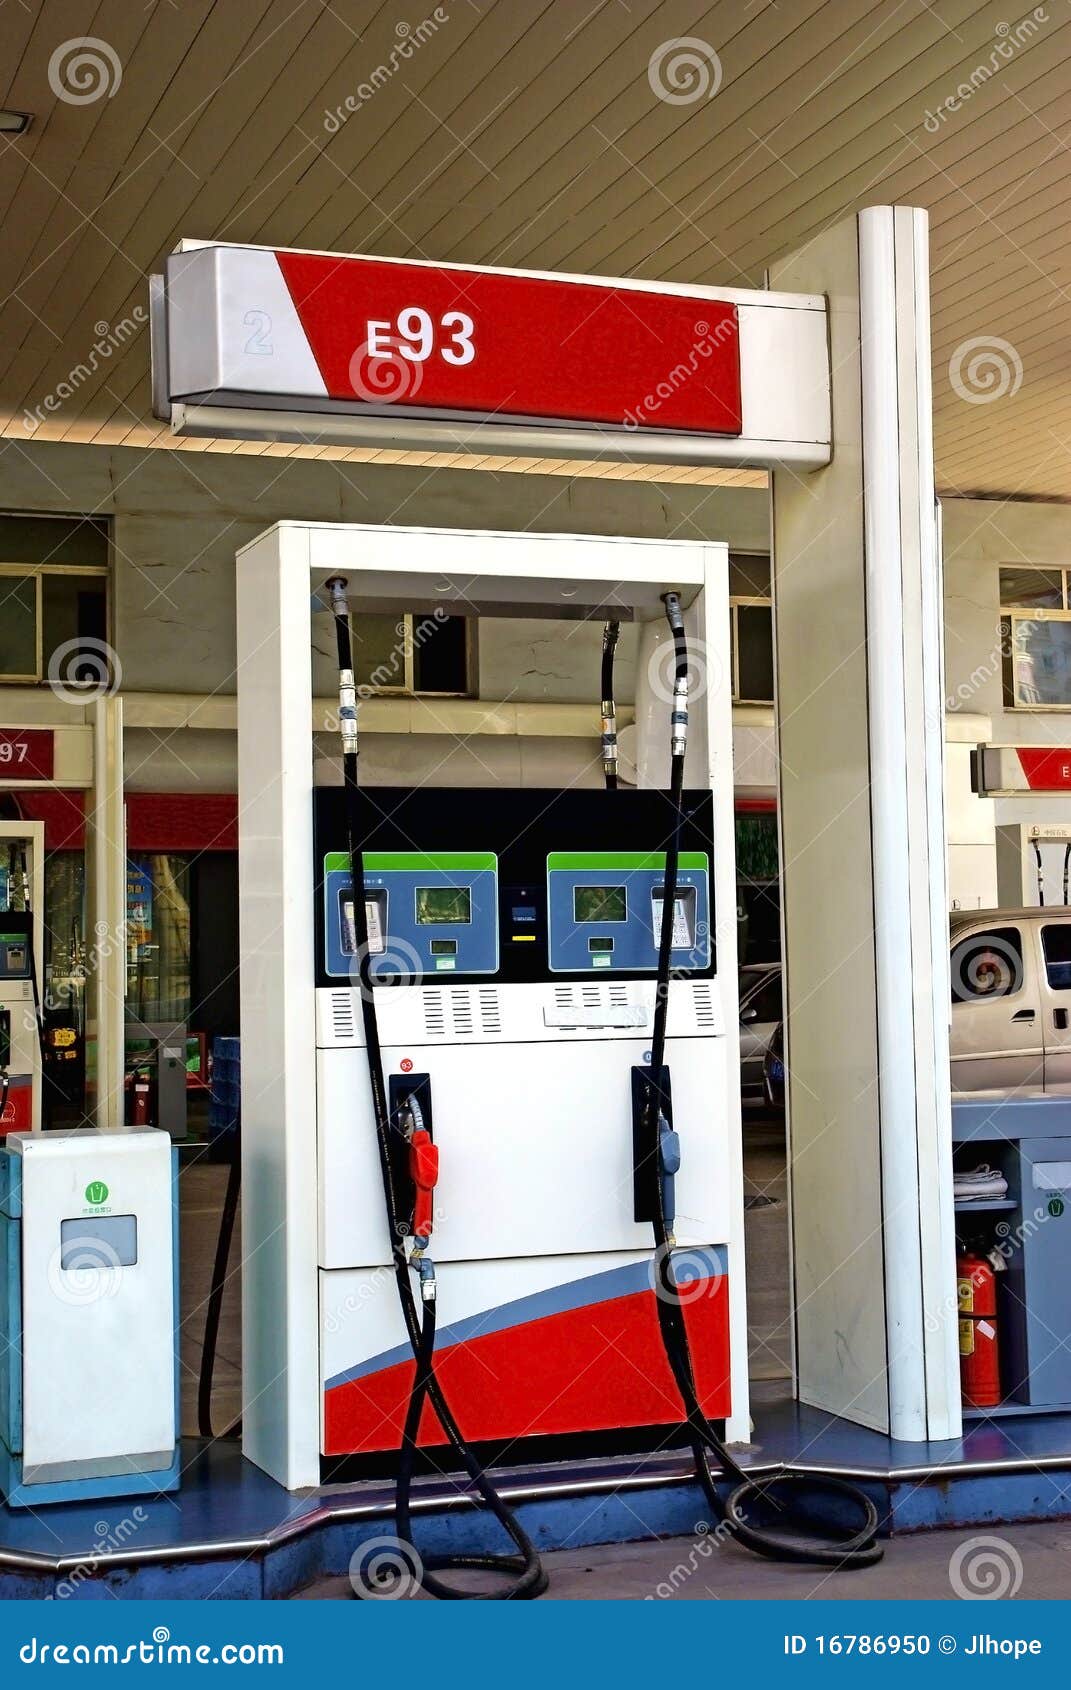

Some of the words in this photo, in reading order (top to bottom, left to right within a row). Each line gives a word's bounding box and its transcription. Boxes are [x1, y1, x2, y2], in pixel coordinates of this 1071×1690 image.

[243, 309, 274, 356] 2
[366, 307, 476, 366] E93
[0, 742, 28, 763] 97
